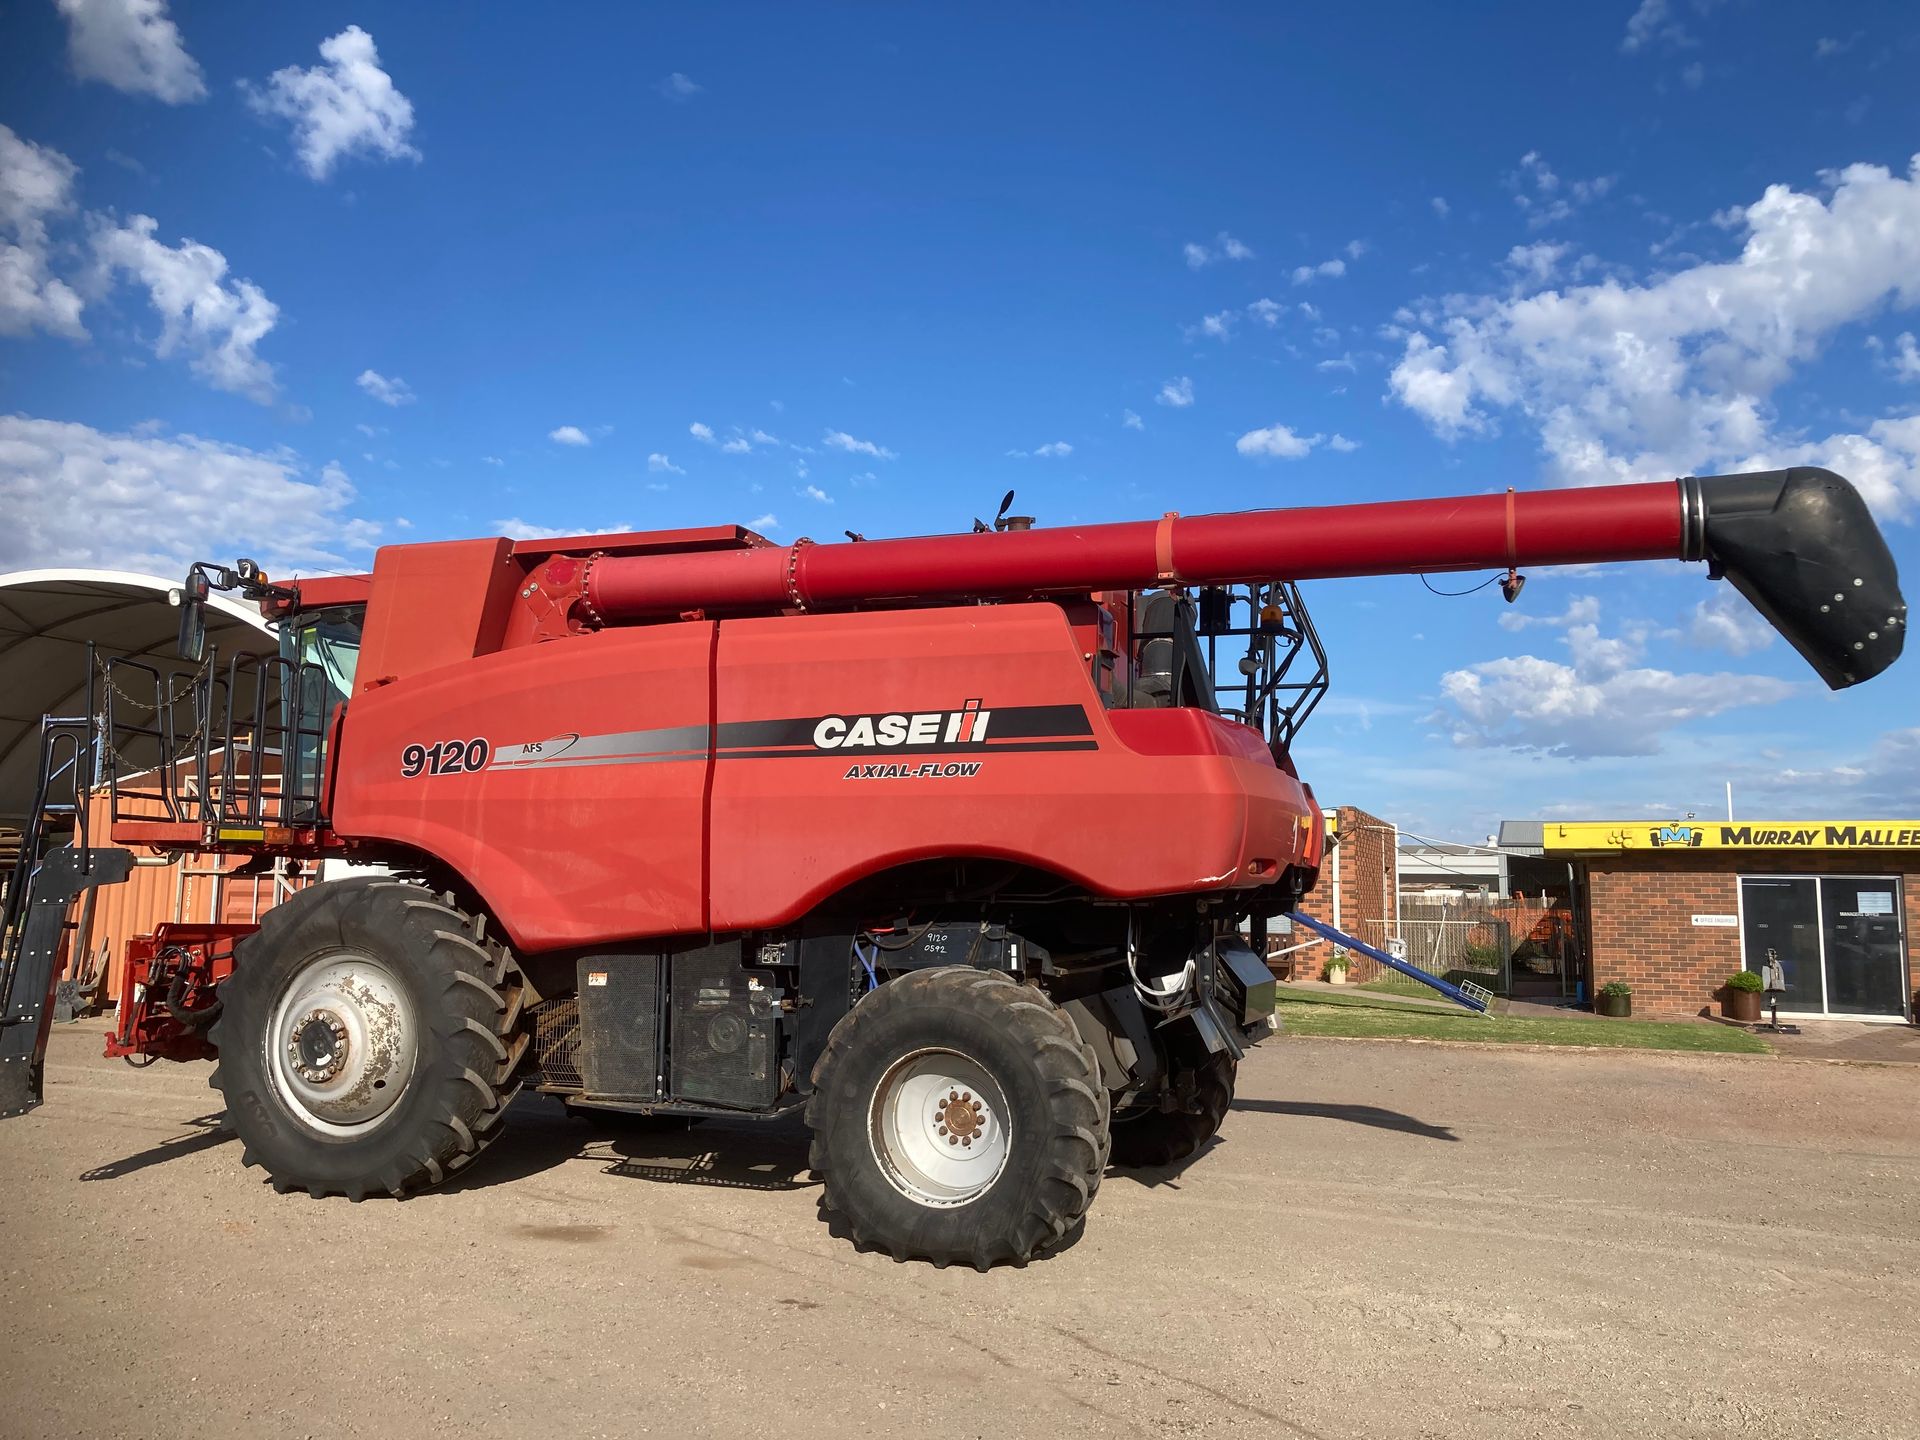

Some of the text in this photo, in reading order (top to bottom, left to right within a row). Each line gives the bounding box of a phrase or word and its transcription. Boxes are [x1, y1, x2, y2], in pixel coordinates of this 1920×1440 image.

[813, 713, 942, 749] CASE
[522, 743, 543, 754] AFS
[401, 737, 490, 778] 9120
[843, 762, 983, 779] AXIAL-FLOW
[1720, 826, 1920, 845] MURRAY MALLEE
[927, 932, 948, 942] 9120
[924, 944, 948, 953] 0592
